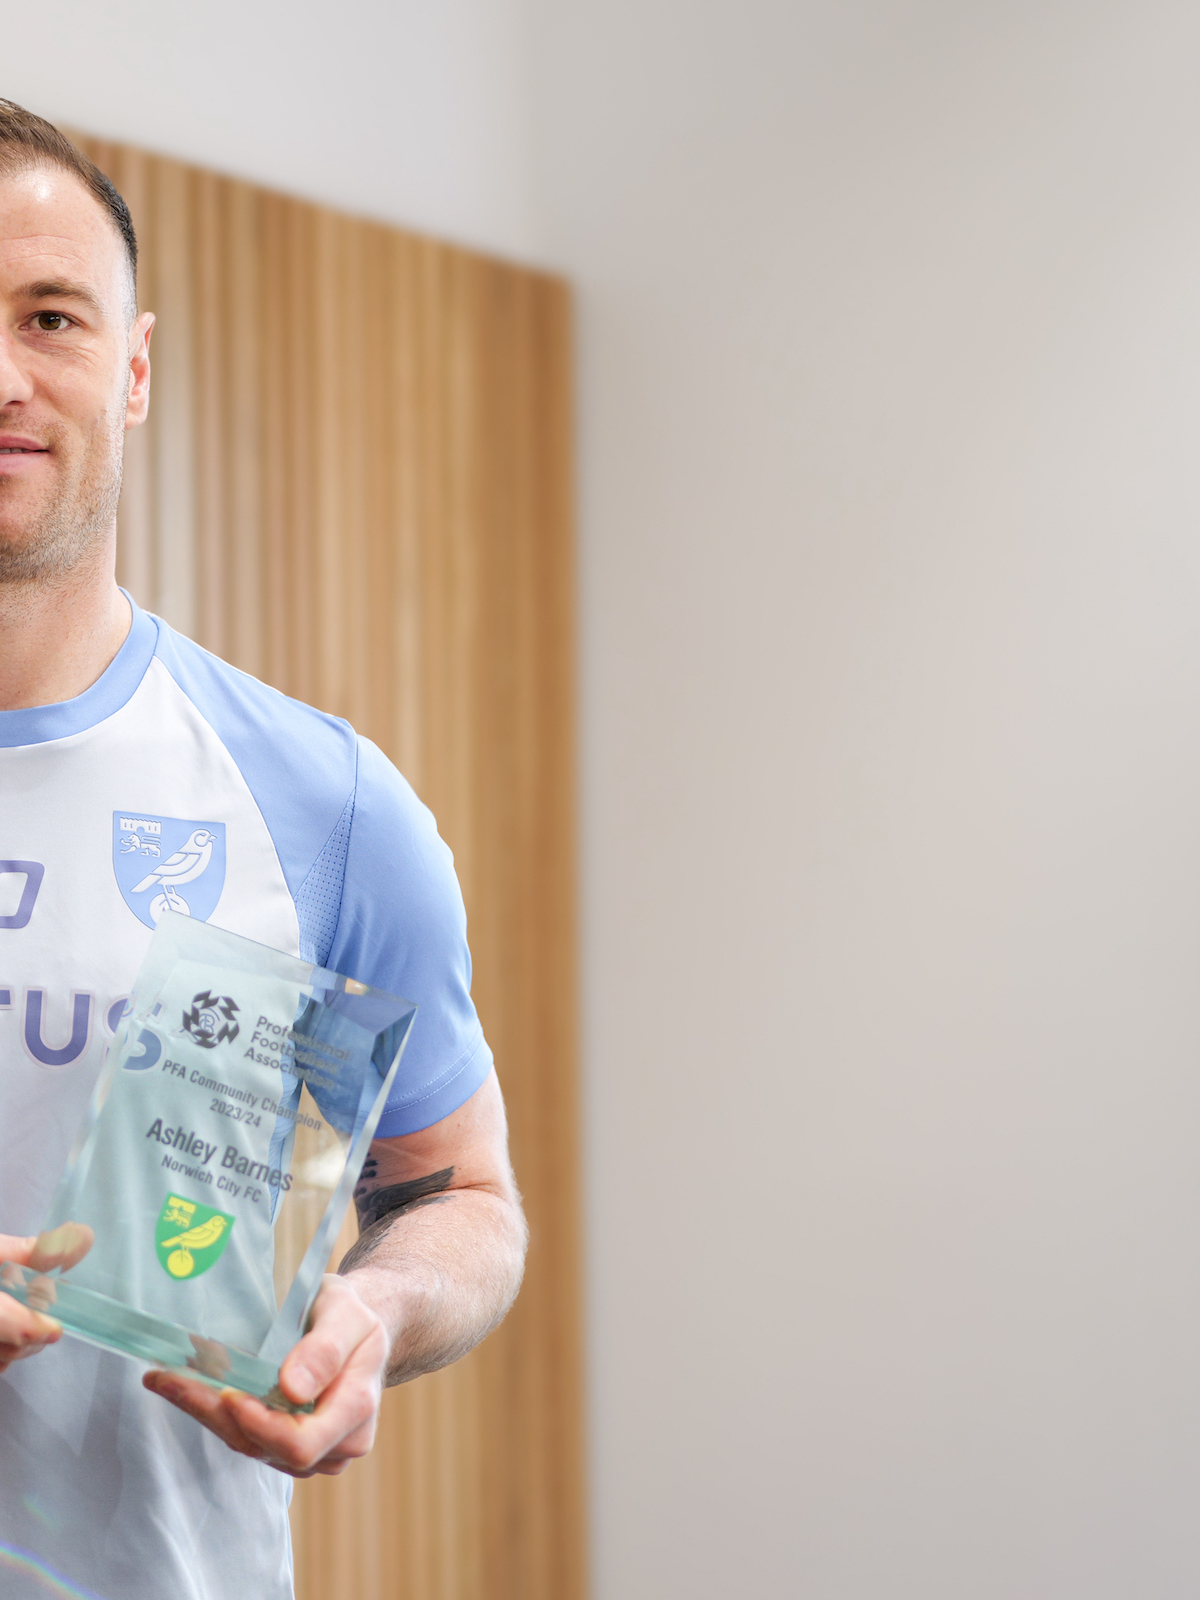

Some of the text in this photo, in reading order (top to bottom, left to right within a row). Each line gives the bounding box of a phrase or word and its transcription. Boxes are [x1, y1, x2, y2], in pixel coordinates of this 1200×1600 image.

[162, 1059, 322, 1131] PFA Community Champion
[209, 1098, 262, 1128] 2023/24
[146, 1118, 293, 1191] Ashley Barnes
[161, 1154, 264, 1203] Norwich City FC
